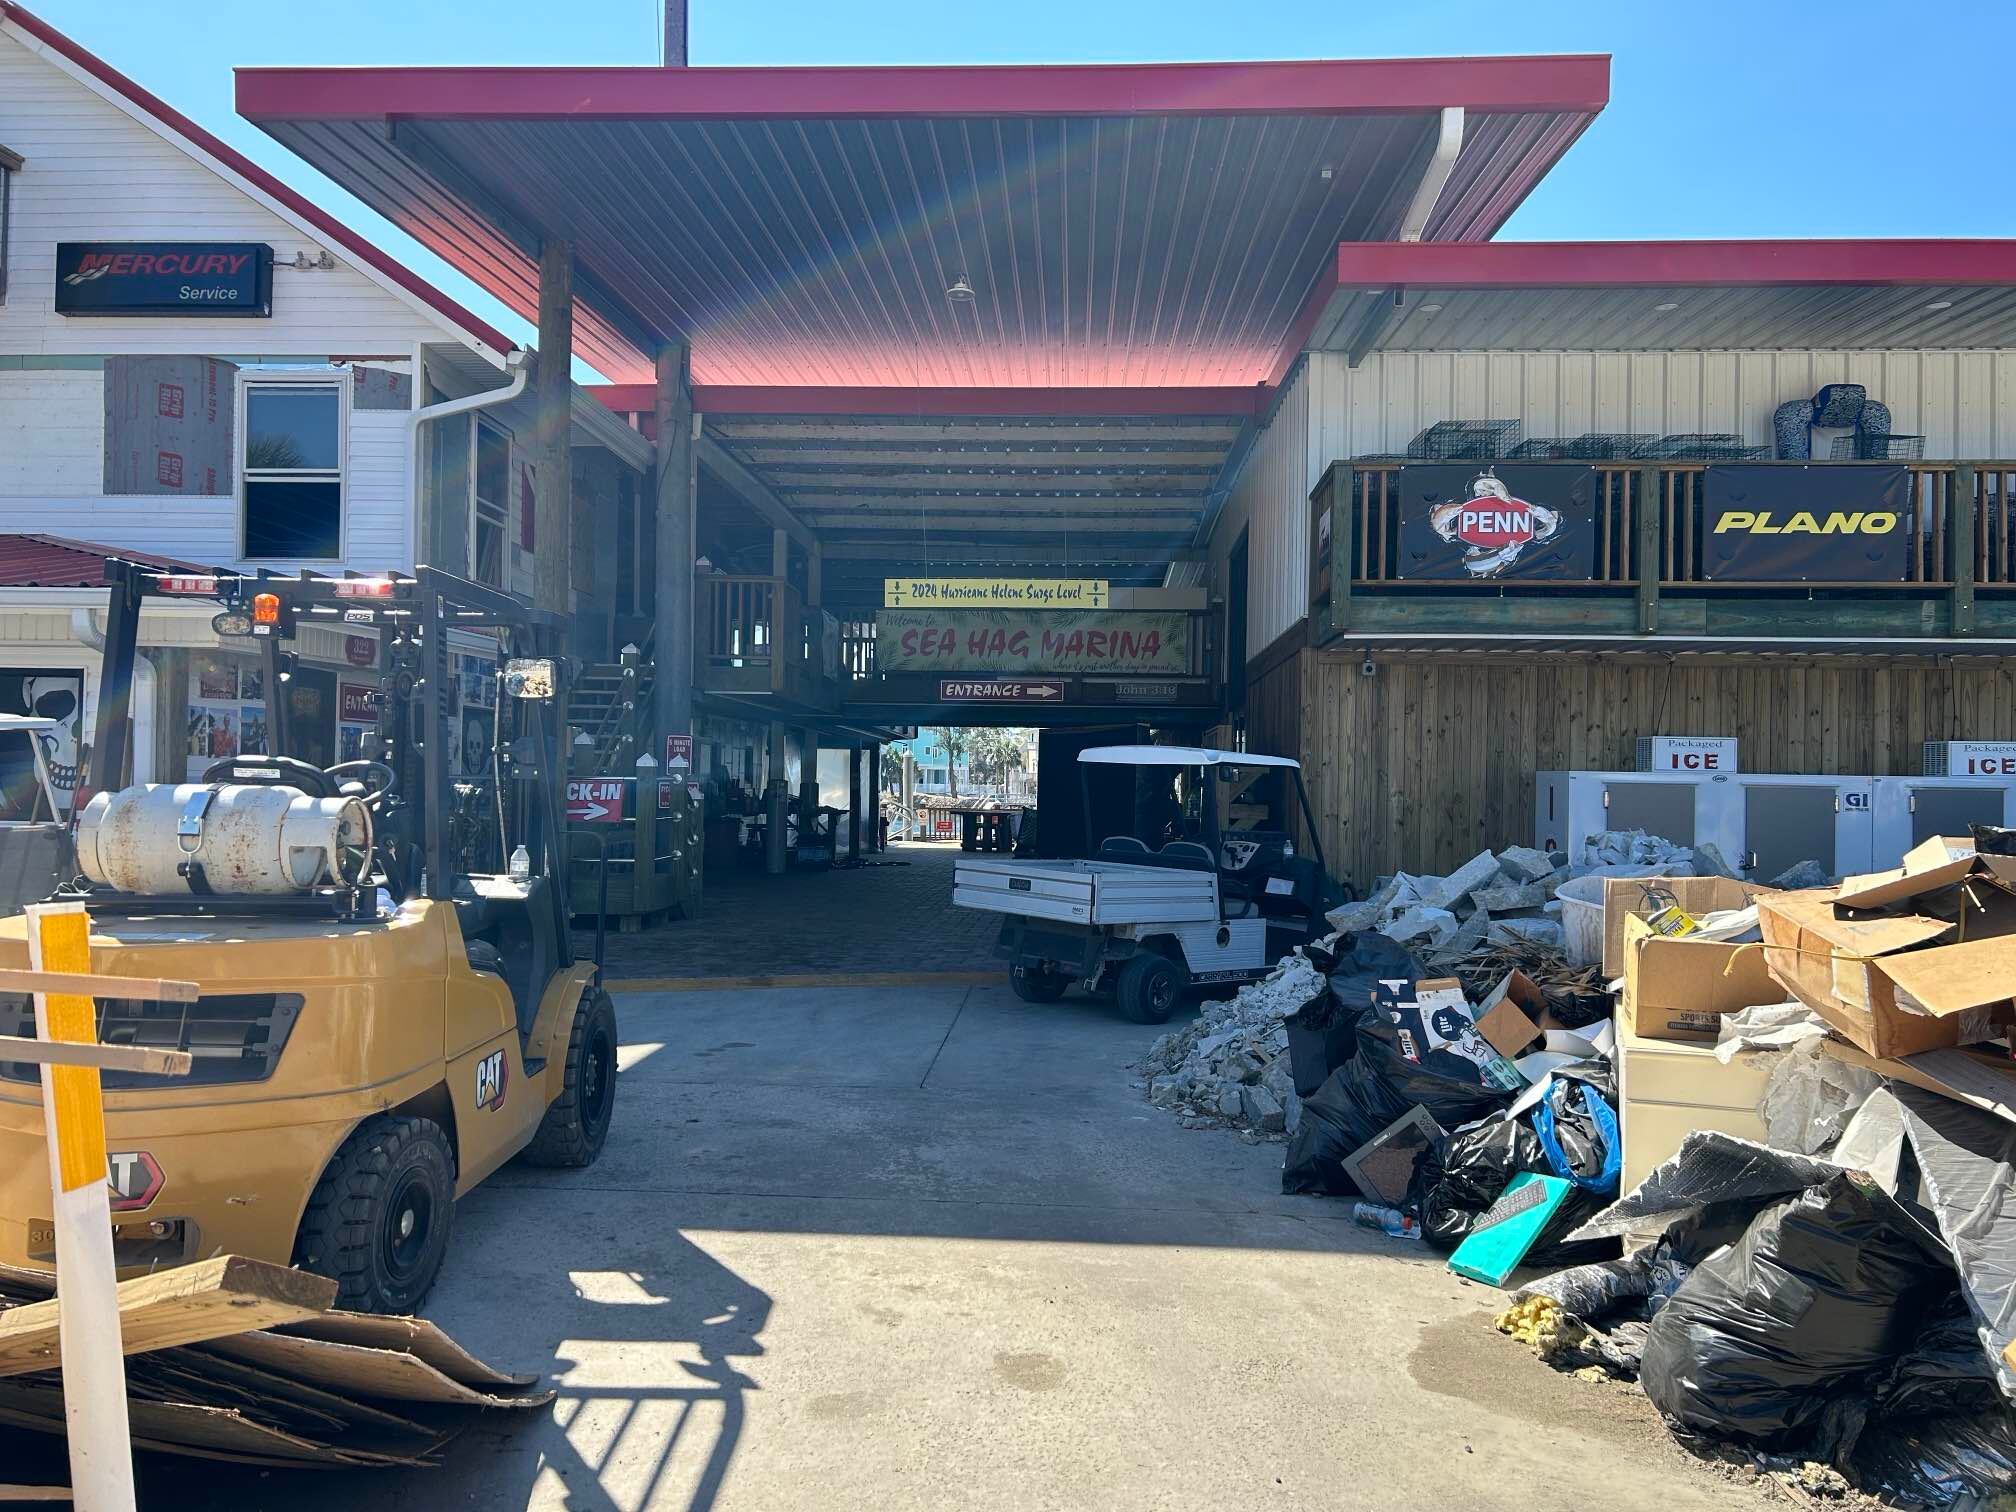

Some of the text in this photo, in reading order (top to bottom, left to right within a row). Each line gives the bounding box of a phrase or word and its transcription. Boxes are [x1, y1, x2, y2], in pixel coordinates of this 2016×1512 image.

[78, 254, 249, 275] MERCURY
[179, 285, 238, 300] Service
[1462, 511, 1530, 533] PENN
[1713, 511, 1897, 534] PLANO
[911, 583, 1082, 603] 2024 Hurricane Helene Surge Level
[886, 612, 923, 626] Welcome
[901, 628, 1161, 660] SEA HAG MARINA
[945, 683, 1022, 697] ENTRANCE
[1115, 683, 1147, 695] John
[345, 693, 378, 713] ENTRAN
[1668, 739, 1723, 749] Packaged
[1671, 753, 1719, 769] ICE
[1968, 757, 2016, 775] ICE
[567, 782, 622, 801] CK-IN
[1845, 793, 1869, 807] GI
[1438, 1016, 1453, 1033] Lite
[476, 1051, 502, 1108] CAT
